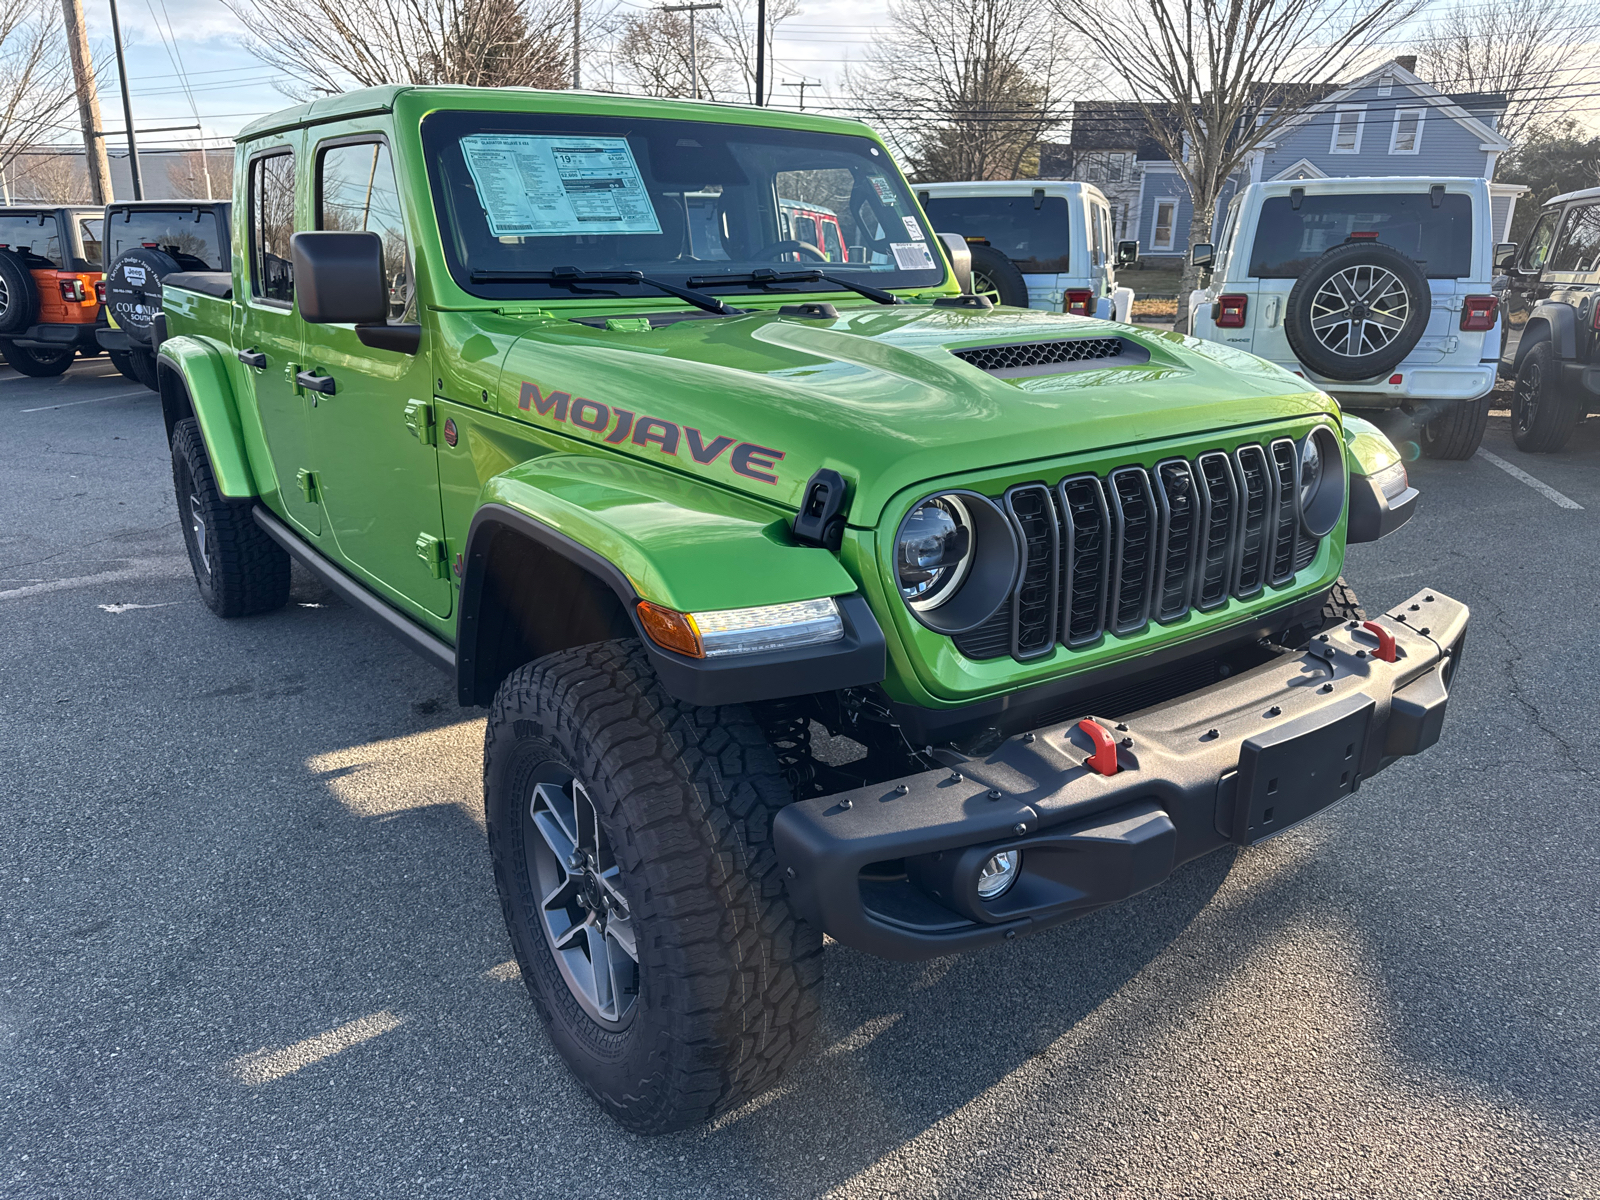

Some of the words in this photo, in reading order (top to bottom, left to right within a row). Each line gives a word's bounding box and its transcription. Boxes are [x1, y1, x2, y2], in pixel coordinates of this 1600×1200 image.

[560, 155, 571, 163] 19
[128, 268, 143, 277] Jeep
[518, 381, 786, 486] MOJAVE
